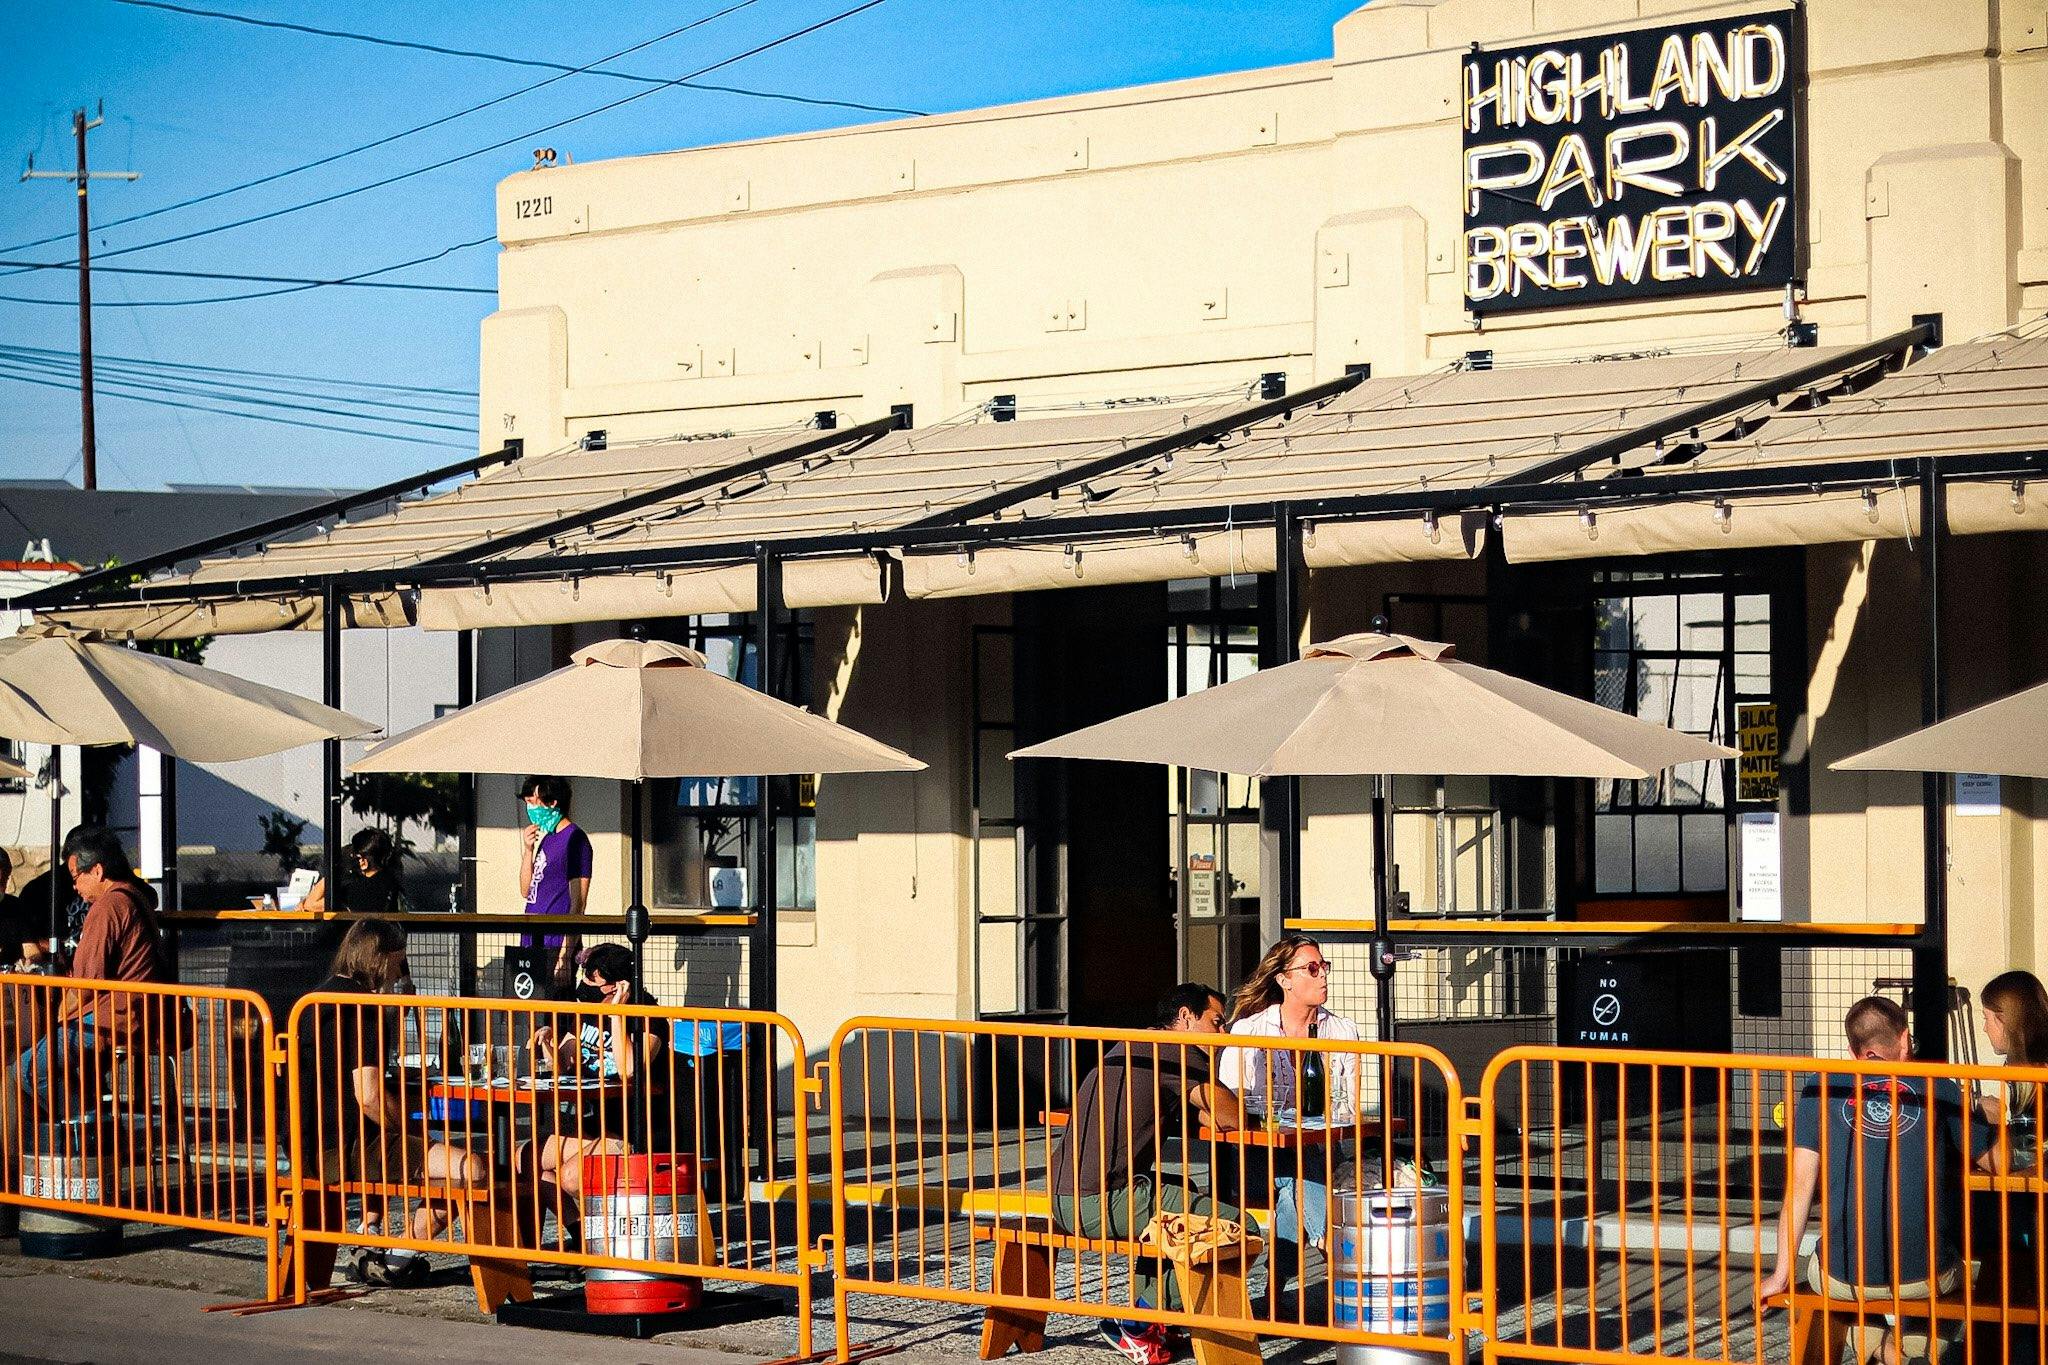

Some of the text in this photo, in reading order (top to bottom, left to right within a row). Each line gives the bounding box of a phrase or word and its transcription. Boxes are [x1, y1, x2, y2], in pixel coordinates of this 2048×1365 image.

[1463, 24, 1786, 134] HIGHLAND
[1463, 108, 1787, 218] PARK
[516, 196, 552, 219] 1220
[1463, 196, 1787, 301] BREWERY
[1740, 709, 1777, 729] BLAC
[1741, 731, 1777, 752] LIVE
[1740, 754, 1779, 773] MATTE
[519, 960, 531, 968] NO
[1600, 979, 1617, 988] NO
[1580, 1031, 1629, 1042] FUMAR
